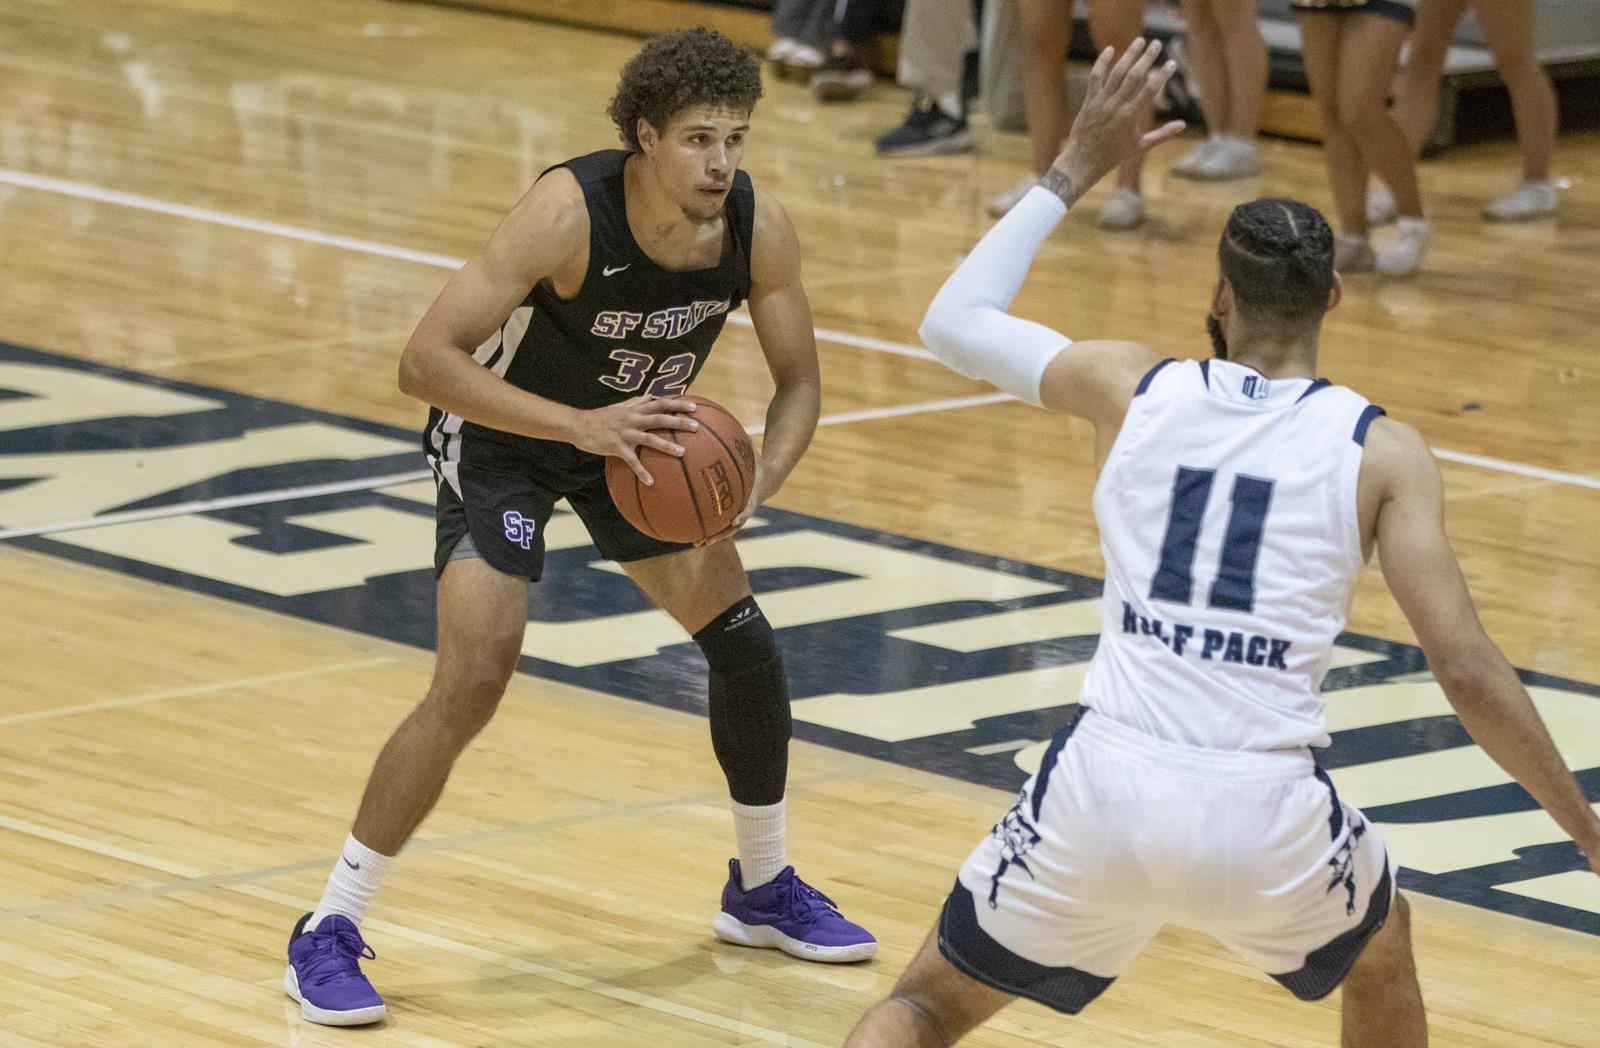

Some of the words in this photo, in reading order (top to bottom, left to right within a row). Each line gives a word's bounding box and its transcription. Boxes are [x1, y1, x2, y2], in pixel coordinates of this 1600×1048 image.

[591, 311, 643, 339] SF
[599, 349, 696, 398] 32
[708, 459, 735, 513] PRO
[503, 510, 535, 550] SF
[1149, 464, 1276, 614] 11
[1201, 627, 1292, 670] PACK
